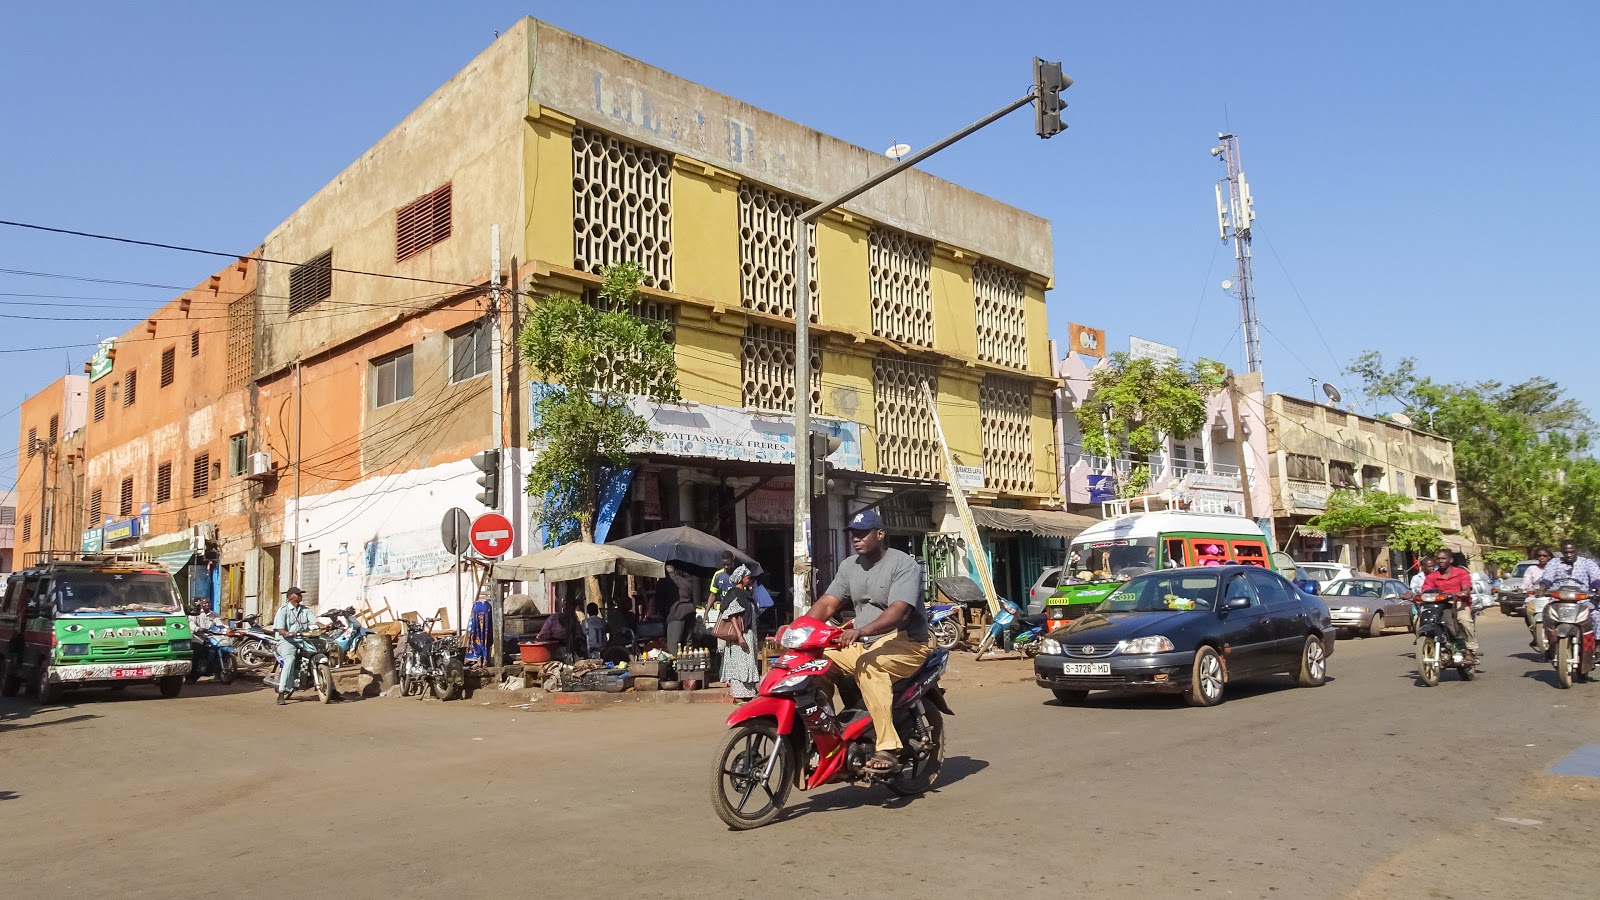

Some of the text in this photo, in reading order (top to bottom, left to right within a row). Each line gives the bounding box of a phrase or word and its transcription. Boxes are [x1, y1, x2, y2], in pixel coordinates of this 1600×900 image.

[662, 432, 786, 450] YATTASSAYE & FRERES
[1065, 663, 1109, 674] S-3728-MD
[805, 705, 818, 715] TVS
